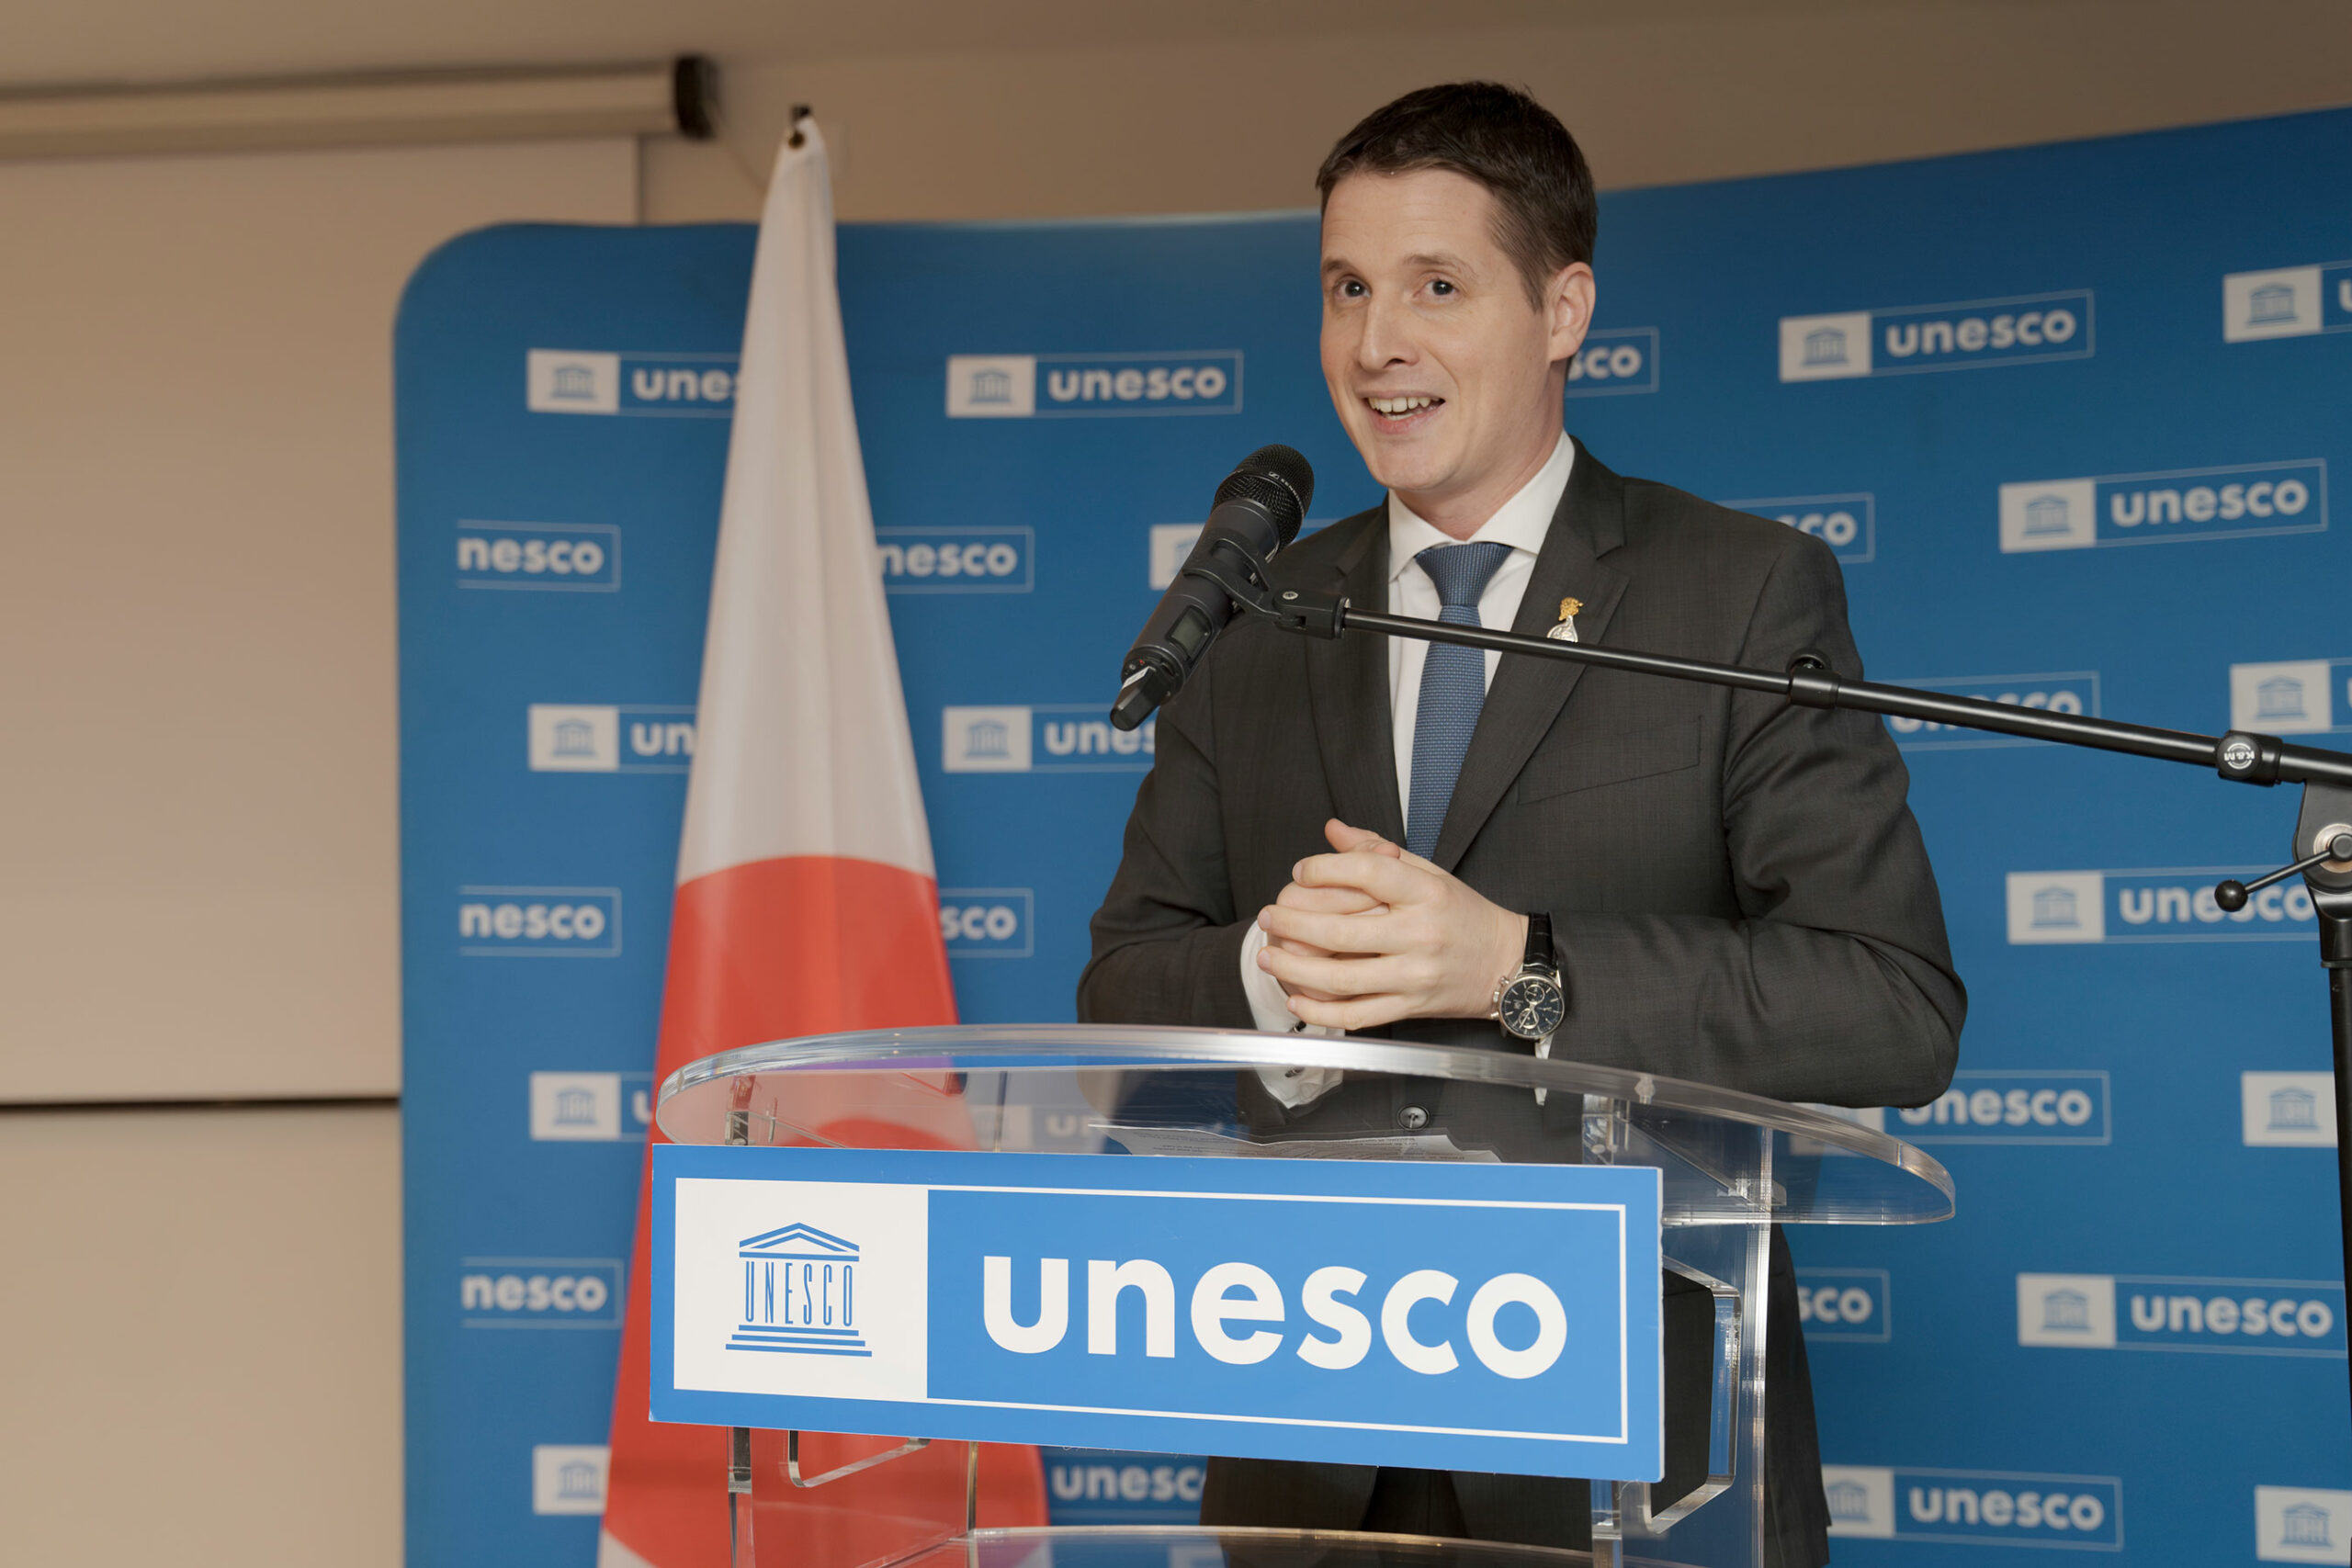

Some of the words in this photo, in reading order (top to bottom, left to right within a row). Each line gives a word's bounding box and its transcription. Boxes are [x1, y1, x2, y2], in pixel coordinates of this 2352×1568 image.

[1886, 310, 2076, 357] unesco
[632, 369, 738, 402] une
[1048, 367, 1227, 401] unesco
[2110, 479, 2309, 527] unesco
[876, 543, 1017, 577] nesco
[940, 906, 1017, 941] sco
[746, 1261, 853, 1326] UNESCO
[1797, 1287, 1873, 1323] sco
[983, 1256, 1568, 1380] unesco
[2131, 1295, 2334, 1337] unesco
[1052, 1466, 1205, 1501] unesc
[1909, 1487, 2105, 1531] unesco
